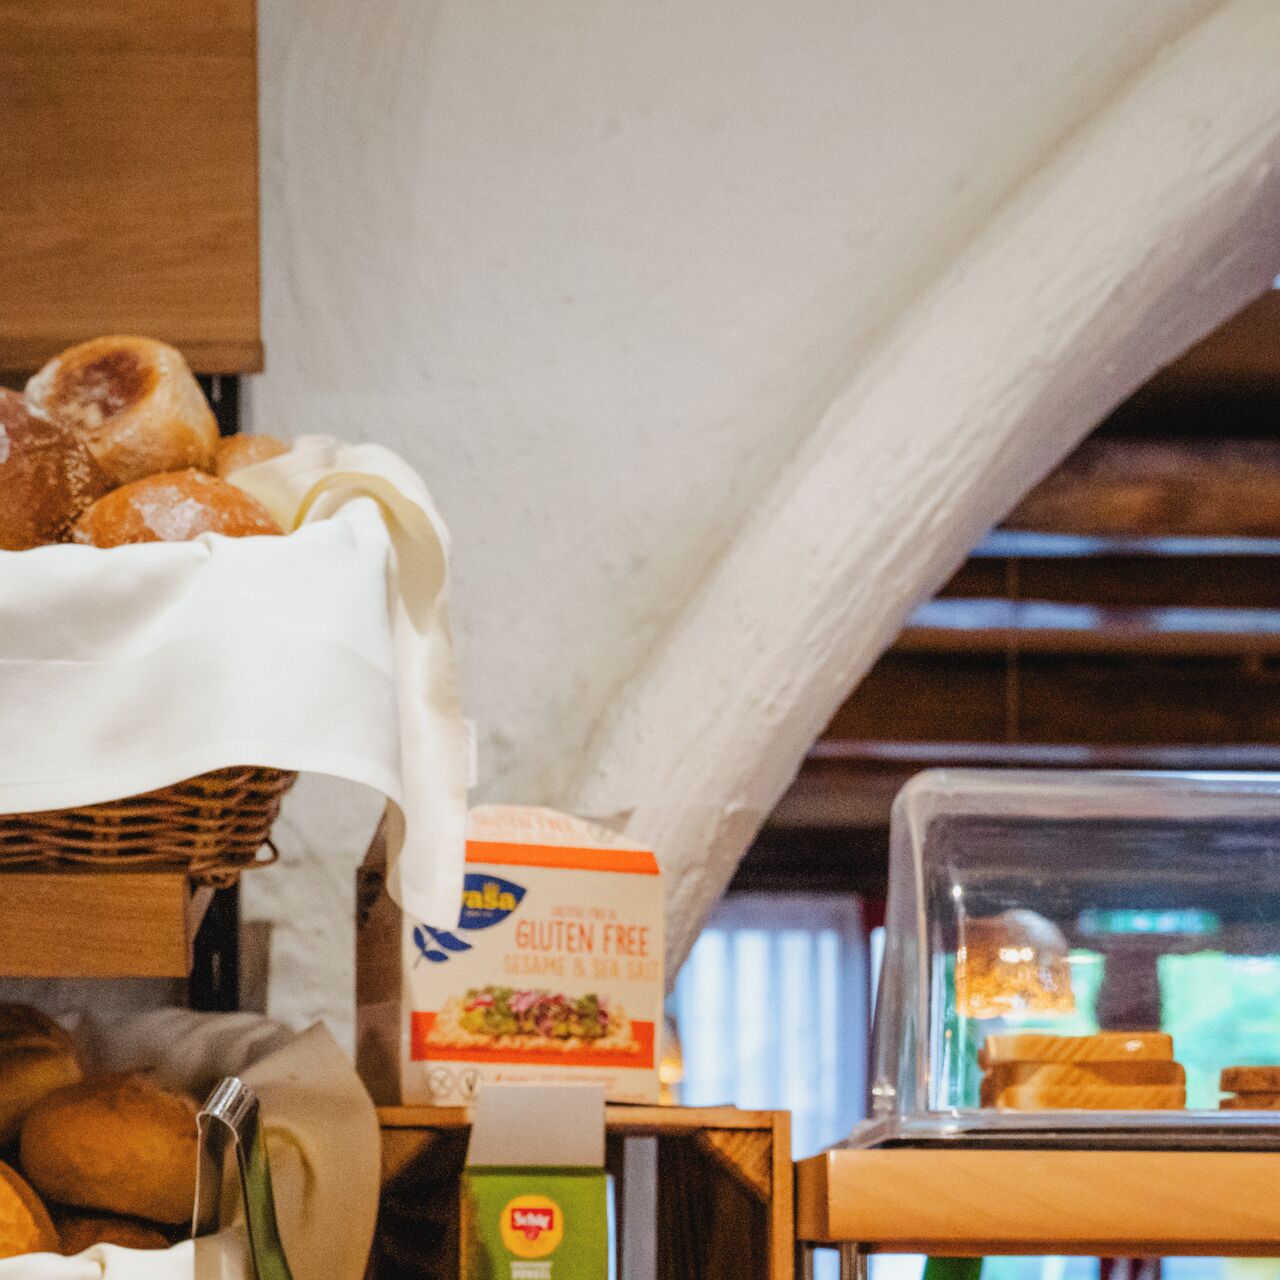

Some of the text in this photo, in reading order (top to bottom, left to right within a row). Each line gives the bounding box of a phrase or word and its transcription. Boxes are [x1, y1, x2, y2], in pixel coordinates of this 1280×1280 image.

[463, 883, 516, 911] asa
[514, 919, 649, 957] GLUTEN FREE
